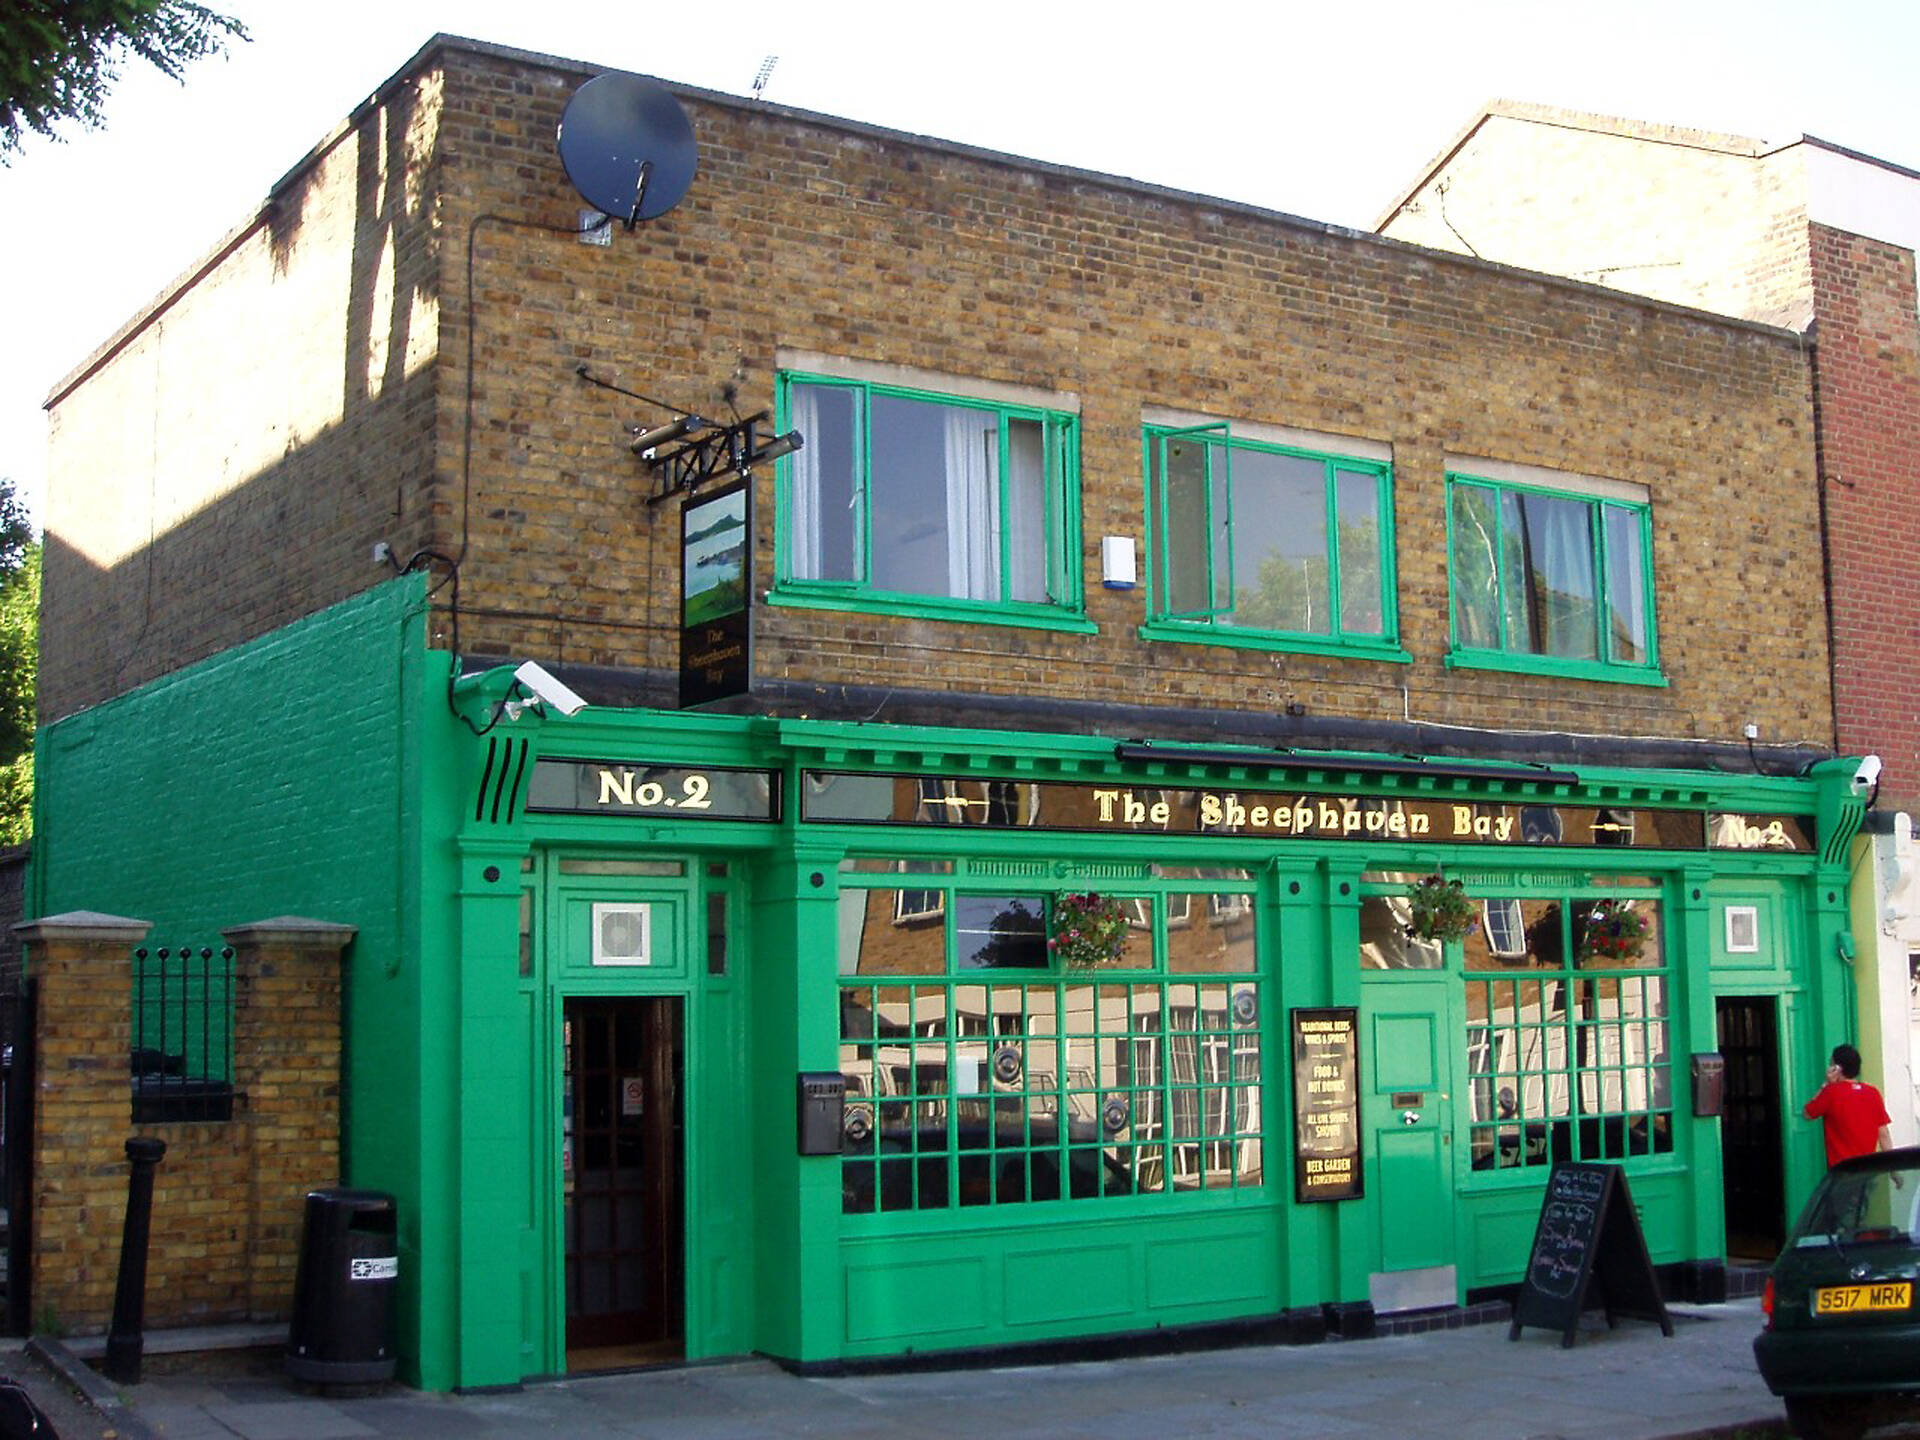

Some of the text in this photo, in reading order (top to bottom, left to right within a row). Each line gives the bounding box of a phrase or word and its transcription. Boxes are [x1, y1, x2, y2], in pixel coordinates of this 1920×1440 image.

[598, 769, 712, 809] No.2
[1093, 789, 1515, 842] The Sheephaven Bay
[1725, 815, 1785, 846] No.2
[1820, 1286, 1907, 1309] S517 MRK
